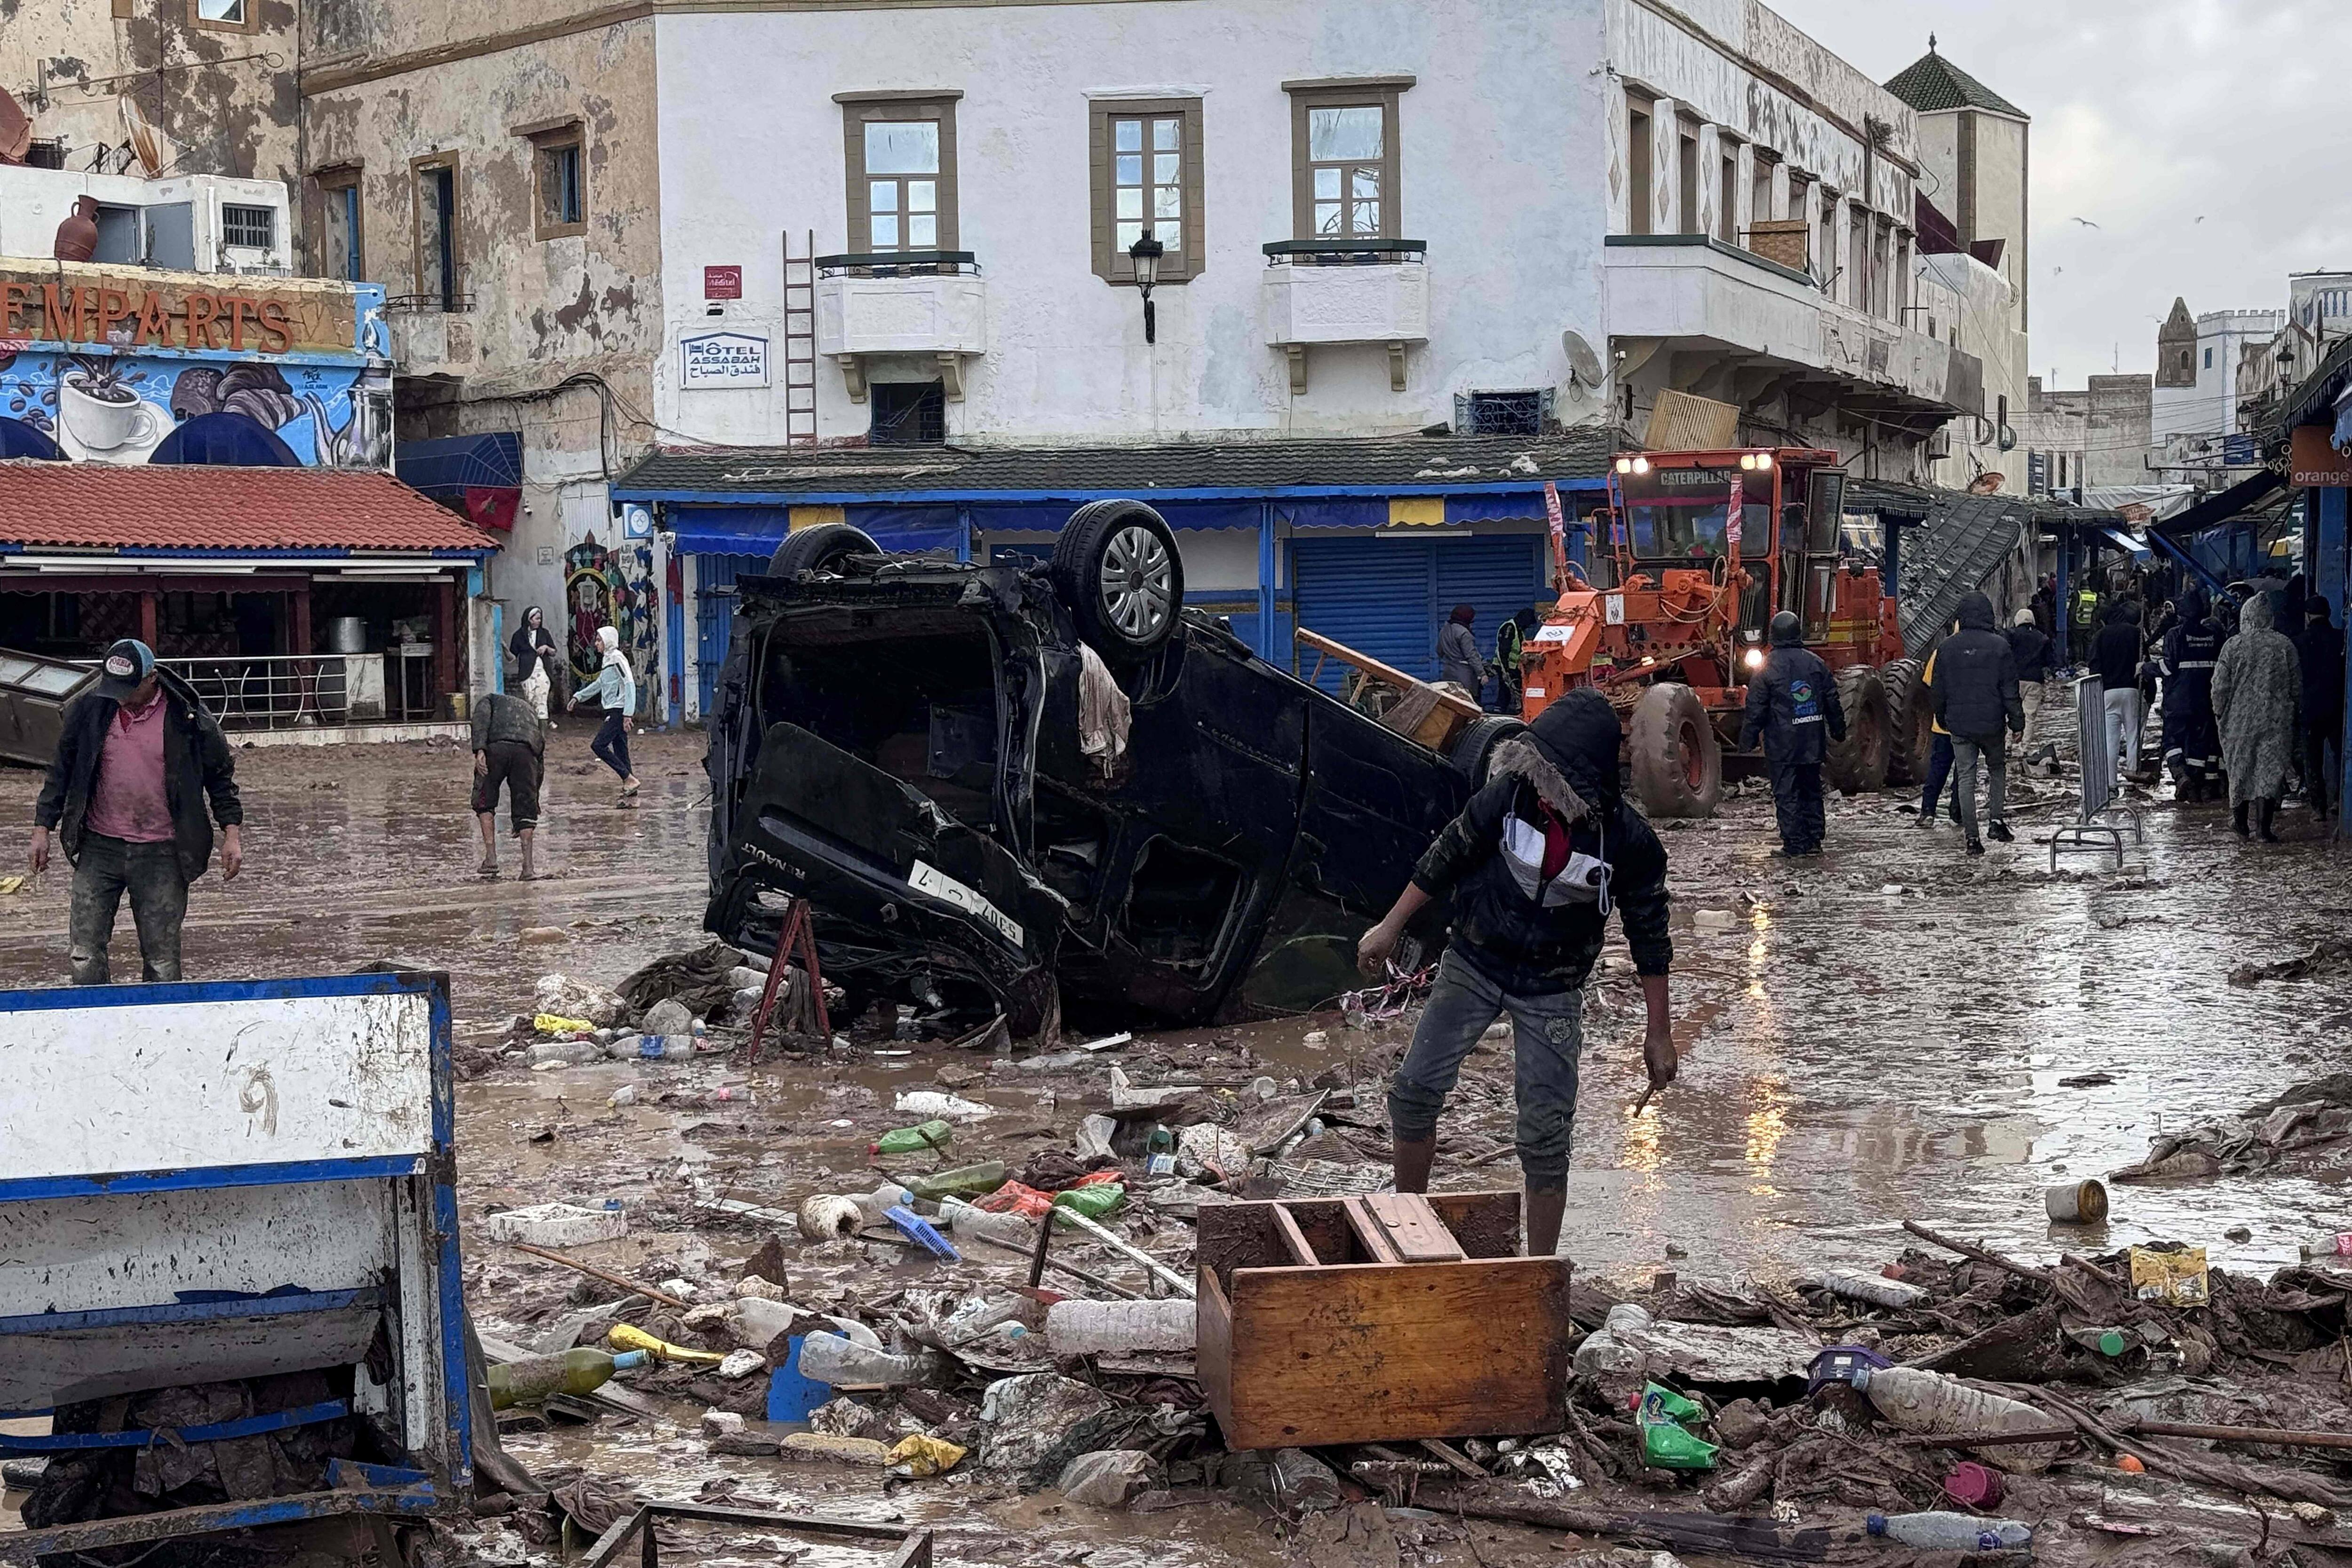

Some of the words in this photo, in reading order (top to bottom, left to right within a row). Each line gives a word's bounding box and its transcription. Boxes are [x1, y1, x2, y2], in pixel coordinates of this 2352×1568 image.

[0, 281, 294, 354] EMPARTS
[689, 342, 761, 356] HÔTEL
[690, 365, 729, 378] الصباح
[730, 365, 761, 376] فندق
[1661, 470, 1731, 485] CATERPILLAR
[2295, 471, 2349, 485] orange
[741, 843, 806, 880] RENAULT
